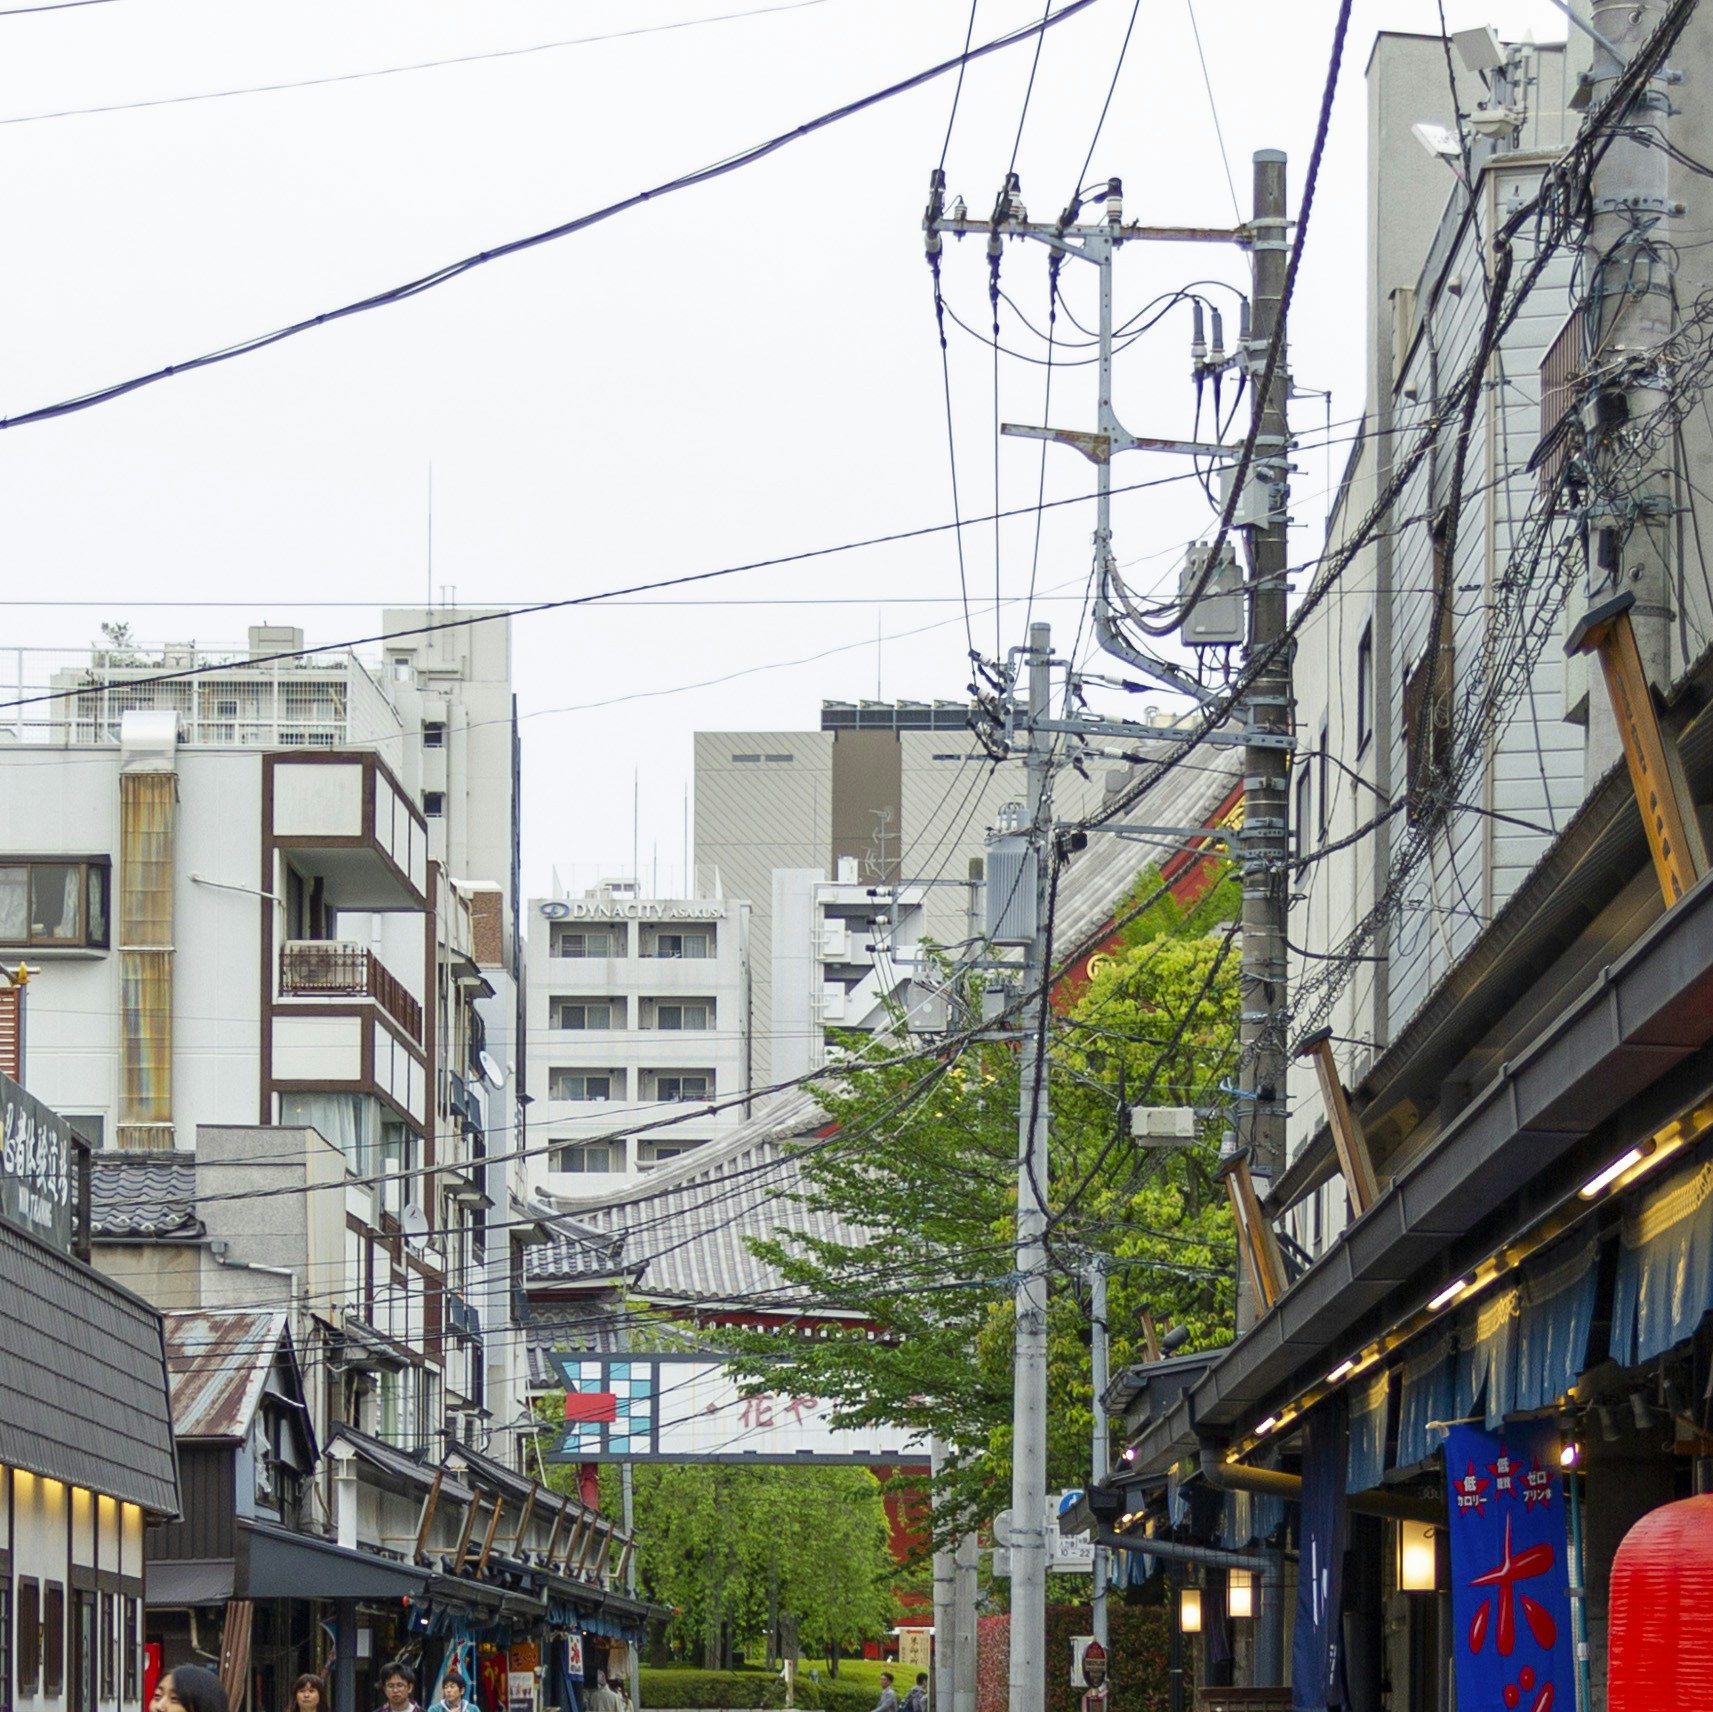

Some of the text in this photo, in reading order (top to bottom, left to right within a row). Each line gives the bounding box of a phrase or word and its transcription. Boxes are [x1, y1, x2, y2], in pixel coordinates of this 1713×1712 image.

[573, 903, 727, 918] DYNACITY ASAKUSA
[1463, 1475, 1477, 1492] 低
[1527, 1470, 1547, 1486] ゼロ
[1457, 1494, 1488, 1507] カロリー
